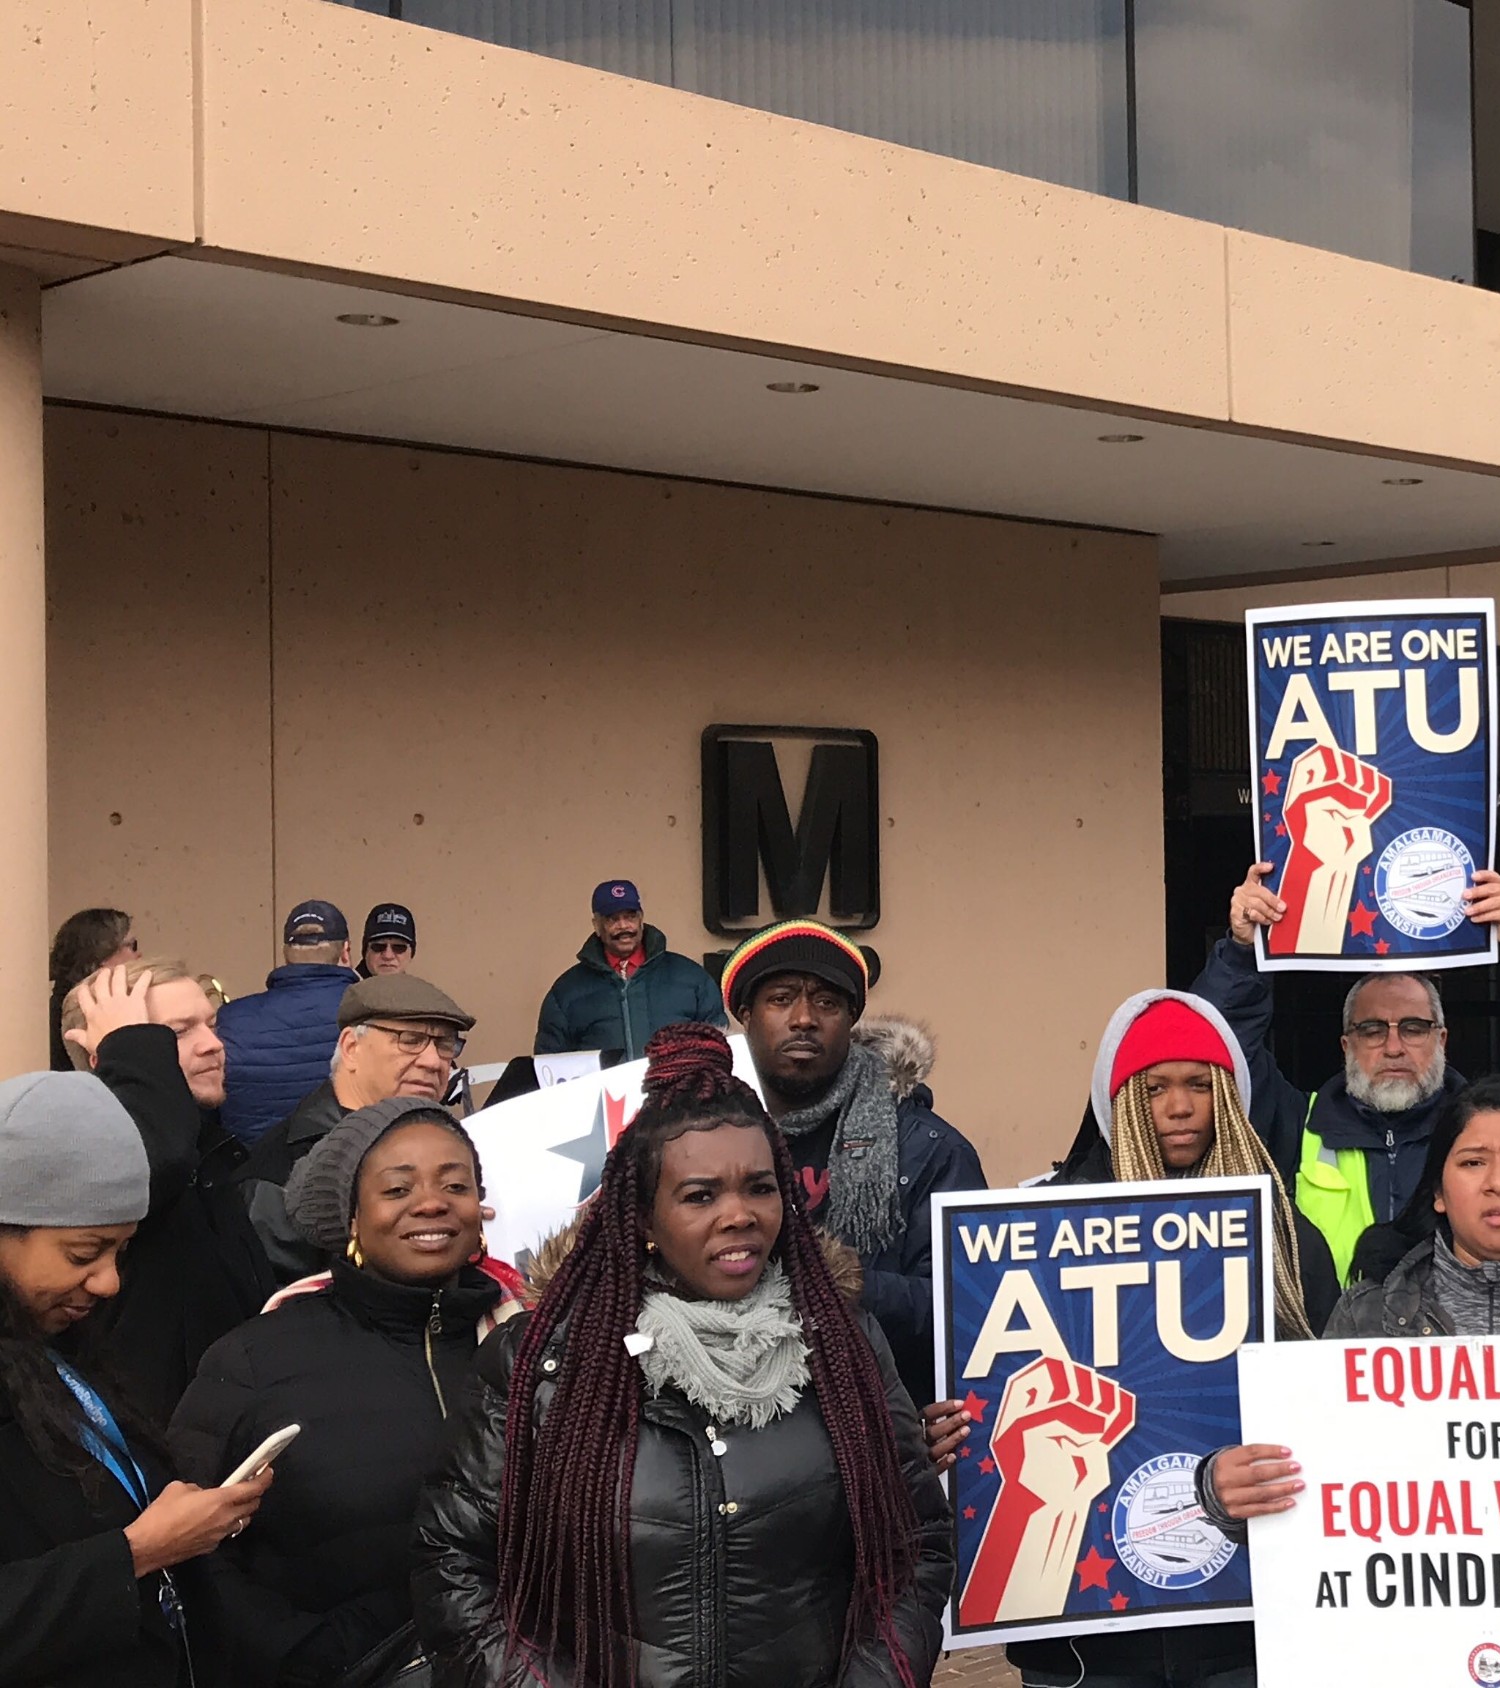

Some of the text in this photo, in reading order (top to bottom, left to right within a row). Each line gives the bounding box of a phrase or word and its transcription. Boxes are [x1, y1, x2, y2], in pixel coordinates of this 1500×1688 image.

[1262, 628, 1478, 668] WE ARE ONE
[1264, 667, 1480, 760] ATU
[1380, 830, 1470, 872] AMALGAMATED
[1378, 891, 1471, 936] TRANSIT UNIO
[958, 1210, 1248, 1263] WE ARE ONE
[962, 1256, 1250, 1379] ATU
[1119, 1456, 1199, 1509] AMALGAM
[1320, 1480, 1485, 1543] EQUAL
[1116, 1533, 1234, 1586] TRANSIT UNIO
[1314, 1570, 1352, 1609] AT
